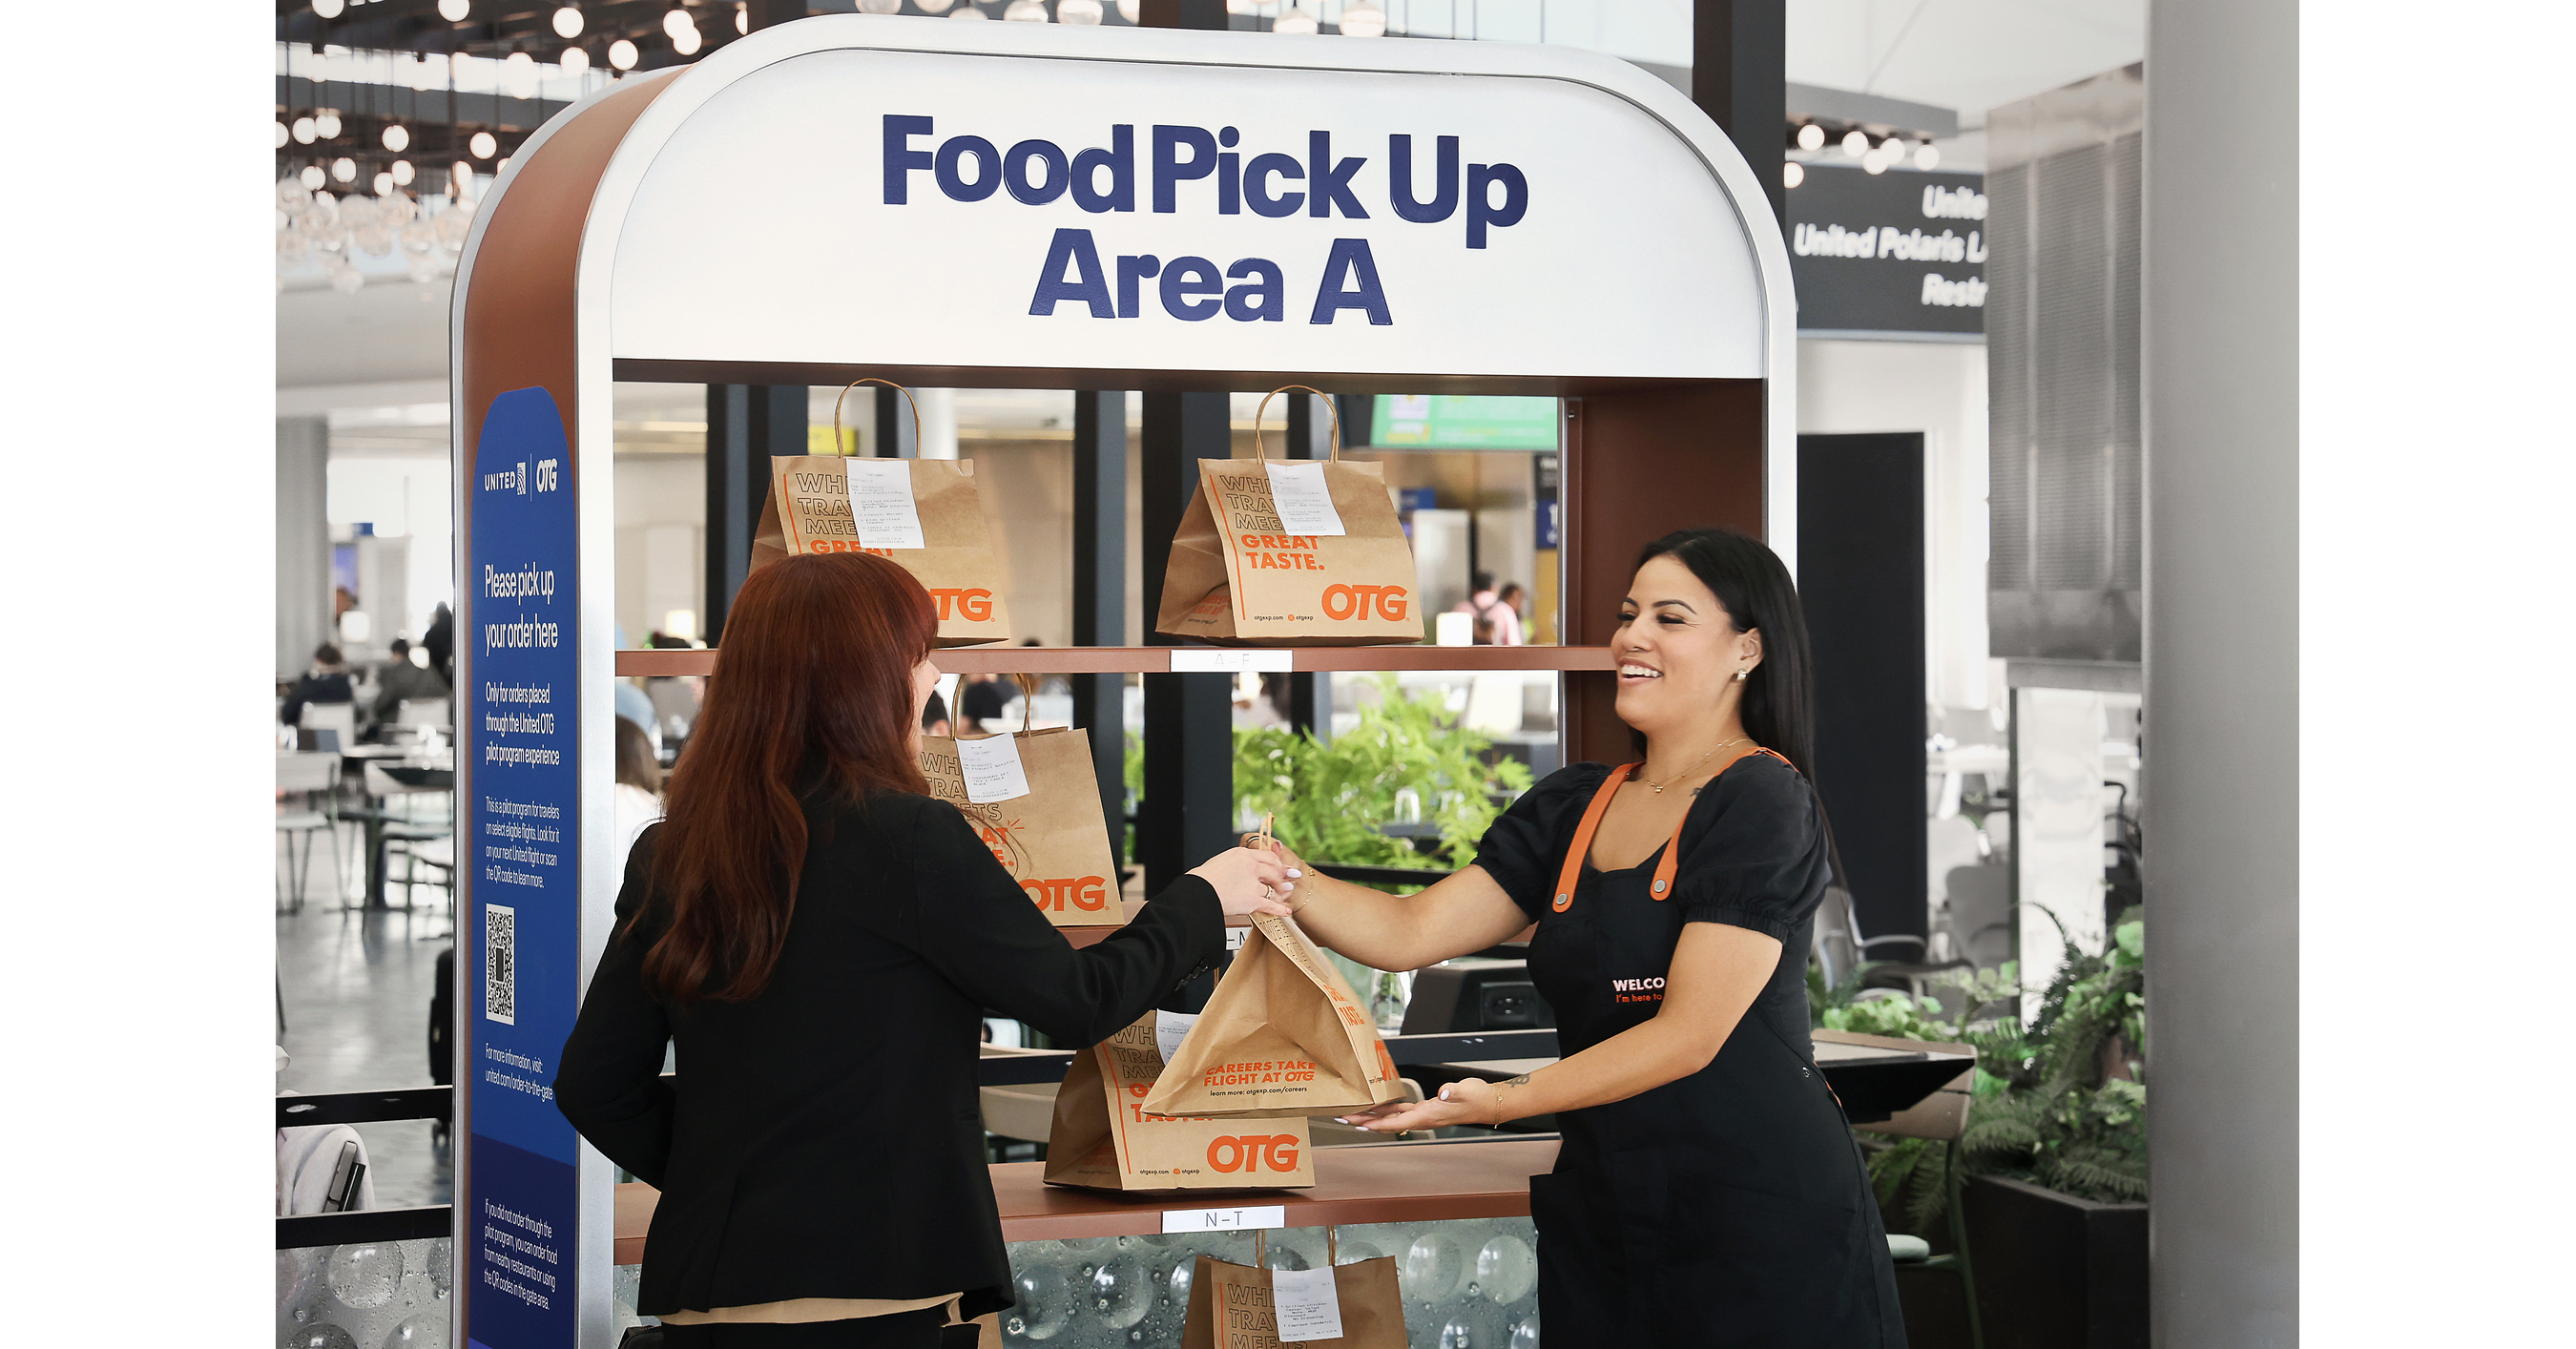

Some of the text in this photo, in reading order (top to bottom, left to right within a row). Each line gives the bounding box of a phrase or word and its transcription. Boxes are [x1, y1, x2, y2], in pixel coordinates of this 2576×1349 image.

[882, 114, 1528, 249] Food Pick Up
[1922, 184, 1988, 220] Unite
[1794, 222, 1988, 263] United Polaris L
[1028, 228, 1393, 326] Area A
[1922, 273, 1988, 307] Restr
[485, 458, 558, 493] UNITED OTG
[796, 473, 848, 495] WH
[1219, 475, 1273, 494] WH
[798, 498, 852, 516] TRA
[1225, 493, 1275, 513] TRA
[805, 518, 859, 535] MEE
[1235, 513, 1284, 530] MEE
[1240, 534, 1319, 550] GREAT
[1245, 552, 1325, 571] TASTE.
[485, 561, 554, 606] Please pick up
[924, 588, 992, 622] TG
[1321, 583, 1407, 622] OTG
[485, 613, 558, 657] your order here
[486, 681, 551, 708] Only for orders placed
[486, 712, 554, 737] through the United OTG
[486, 740, 560, 769] pilot program experience
[486, 796, 495, 812] This
[494, 798, 499, 813] is
[502, 799, 512, 817] pilot
[512, 802, 532, 820] program
[531, 800, 540, 817] for
[539, 802, 560, 820] travelers
[486, 822, 492, 835] on
[491, 820, 506, 836] select
[506, 820, 522, 841] eligible
[537, 824, 549, 841] Look
[486, 844, 558, 868] on your next United flight or scan
[486, 864, 494, 881] the
[493, 865, 502, 883] QR
[501, 867, 513, 883] code
[513, 869, 518, 884] to
[518, 868, 530, 885] learn
[1018, 876, 1106, 911] OTG
[1612, 977, 1666, 991] WELCO
[1616, 994, 1630, 1003] I'm
[492, 1048, 506, 1063] more
[1113, 1048, 1161, 1063] TRA
[1206, 1060, 1317, 1075] CAREERS TAKE
[1204, 1071, 1315, 1087] FLIGHT AT OTG
[1246, 1086, 1308, 1095] otgexp.com/careers
[1207, 1133, 1299, 1173] OTG
[488, 1204, 497, 1219] you
[496, 1203, 505, 1220] did
[512, 1210, 526, 1228] order
[525, 1214, 544, 1238] through
[544, 1220, 552, 1238] the
[515, 1236, 525, 1253] you
[524, 1240, 533, 1256] can
[532, 1242, 546, 1260] order
[546, 1245, 558, 1265] food
[510, 1259, 537, 1281] restaurants
[542, 1270, 556, 1293] using
[499, 1276, 514, 1295] codes
[526, 1289, 537, 1305] gate
[1227, 1283, 1275, 1307] WH
